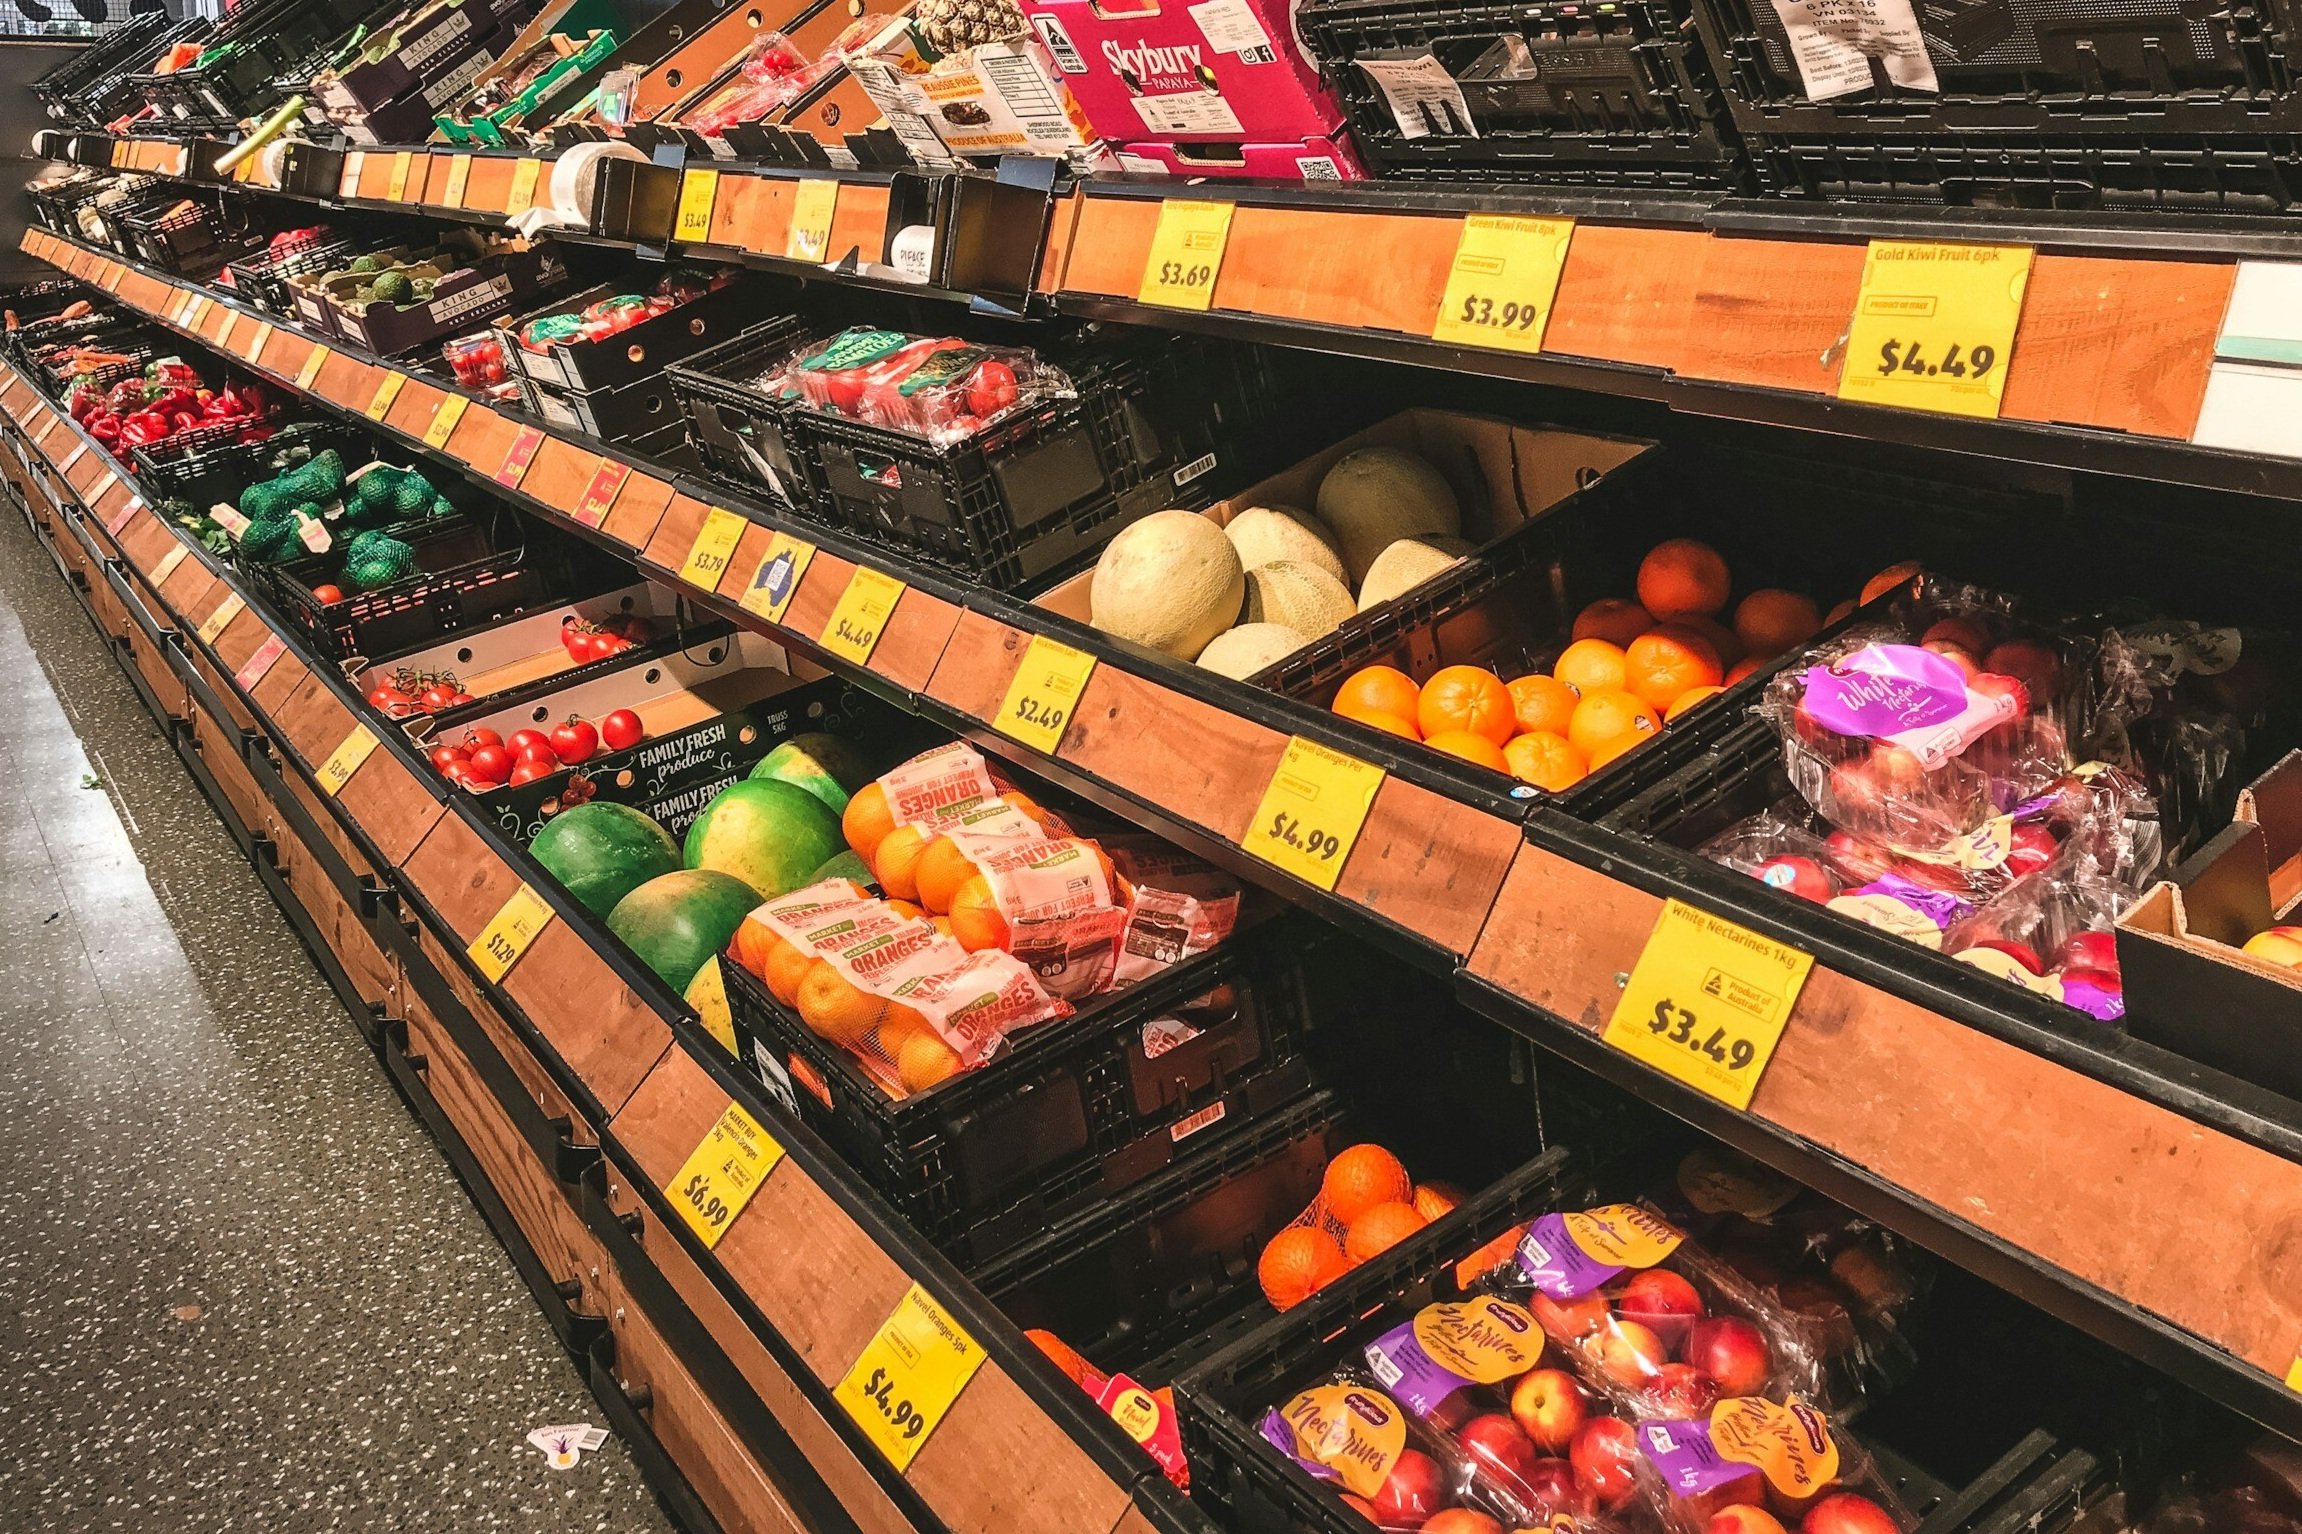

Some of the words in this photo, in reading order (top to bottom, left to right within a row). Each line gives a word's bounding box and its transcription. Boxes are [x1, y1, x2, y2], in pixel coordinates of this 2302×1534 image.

[1812, 10, 1836, 18] VN
[1820, 0, 1840, 9] PK
[1857, 0, 1877, 8] 16
[1812, 19, 1839, 27] ITEM
[409, 30, 440, 55] KING
[1798, 33, 1817, 41] Grown
[412, 36, 448, 64] AVOCADO
[1101, 38, 1201, 83] Skybury
[433, 69, 464, 94] KING
[932, 78, 957, 91] AUSSIE
[956, 74, 981, 88] PINES
[1809, 66, 1823, 74] Best
[1812, 74, 1831, 83] Display
[437, 75, 472, 103] AVOCADO
[1152, 77, 1193, 90] PAPAYA
[944, 135, 978, 147] PRODUCE
[977, 134, 986, 144] OF
[986, 132, 1028, 145] AUSTRALIA
[684, 212, 707, 229] $3.49
[1469, 218, 1494, 228] Green
[1494, 219, 1514, 230] Kiwi
[1515, 221, 1538, 233] Fruit
[1538, 224, 1557, 237] 8pk
[1875, 248, 1904, 262] Gold
[1906, 247, 1937, 262] Kiwi
[1938, 248, 1971, 262] Fruit
[1973, 248, 2001, 265] 6pk
[1159, 260, 1211, 287] $3.69
[441, 288, 477, 309] KING
[442, 297, 485, 319] AVOCADO
[1870, 301, 1899, 309] PRODUCT
[1909, 302, 1929, 310] ITALY
[1460, 294, 1536, 331] $3.99
[825, 332, 906, 369] TOMATOES
[826, 333, 884, 363] GOURMET
[1877, 337, 1996, 381] $4.49
[694, 550, 724, 572] $3.79
[835, 617, 873, 649] $4.49
[1836, 673, 1896, 712] White
[767, 710, 789, 725] TRUSS
[1015, 695, 1064, 730] $2.49
[772, 721, 787, 735] 5KG
[639, 736, 686, 769] FAMILY
[685, 723, 727, 753] FRESH
[1288, 752, 1299, 763] kg
[1294, 739, 1315, 754] Navel
[1315, 748, 1350, 768] Oranges
[1349, 759, 1364, 772] Per
[657, 749, 716, 784] produce
[899, 778, 981, 817] ORANGES
[926, 780, 942, 790] FOR
[653, 789, 699, 822] FAMILY
[949, 796, 983, 814] MARKET
[975, 806, 1010, 820] MARKET
[1268, 811, 1340, 861] $4.99
[986, 840, 1074, 868] ORANGES
[1042, 850, 1078, 867] MARKET
[1005, 895, 1023, 906] 3kg
[1042, 903, 1059, 916] FOR
[1060, 891, 1096, 910] PERFECT
[809, 924, 843, 941] MARKET
[813, 917, 896, 951] ORANGES
[1671, 904, 1704, 929] White
[1706, 919, 1770, 957] Nectarines
[1774, 948, 1797, 970] 1kg
[486, 931, 516, 964] $1.29
[845, 938, 881, 958] MARKET
[850, 932, 933, 974] ORANGES
[1726, 993, 1764, 1016] Australia
[1728, 981, 1761, 1003] Product
[1761, 994, 1772, 1006] of
[956, 981, 1036, 1042] ORANGES
[1647, 996, 1755, 1072] $3.49
[713, 1127, 724, 1143] 3kg
[728, 1109, 748, 1131] MARKET
[744, 1127, 757, 1141] BUY
[720, 1118, 741, 1142] Valencia
[738, 1136, 758, 1161] Oranges
[683, 1174, 728, 1227] $6.99
[1594, 1235, 1625, 1261] Summer
[911, 1291, 931, 1315] Navel
[927, 1309, 955, 1342] Oranges
[951, 1336, 968, 1356] 5pk
[1436, 1306, 1525, 1363] Nectarines
[889, 1330, 902, 1348] PRODUCT
[863, 1367, 925, 1439] $4.99
[1408, 1393, 1427, 1417] 1kg
[1122, 1403, 1152, 1430] Navel
[1291, 1396, 1387, 1473] Nectarines
[1148, 1443, 1159, 1454] 5
[1679, 1466, 1700, 1488] 1kg
